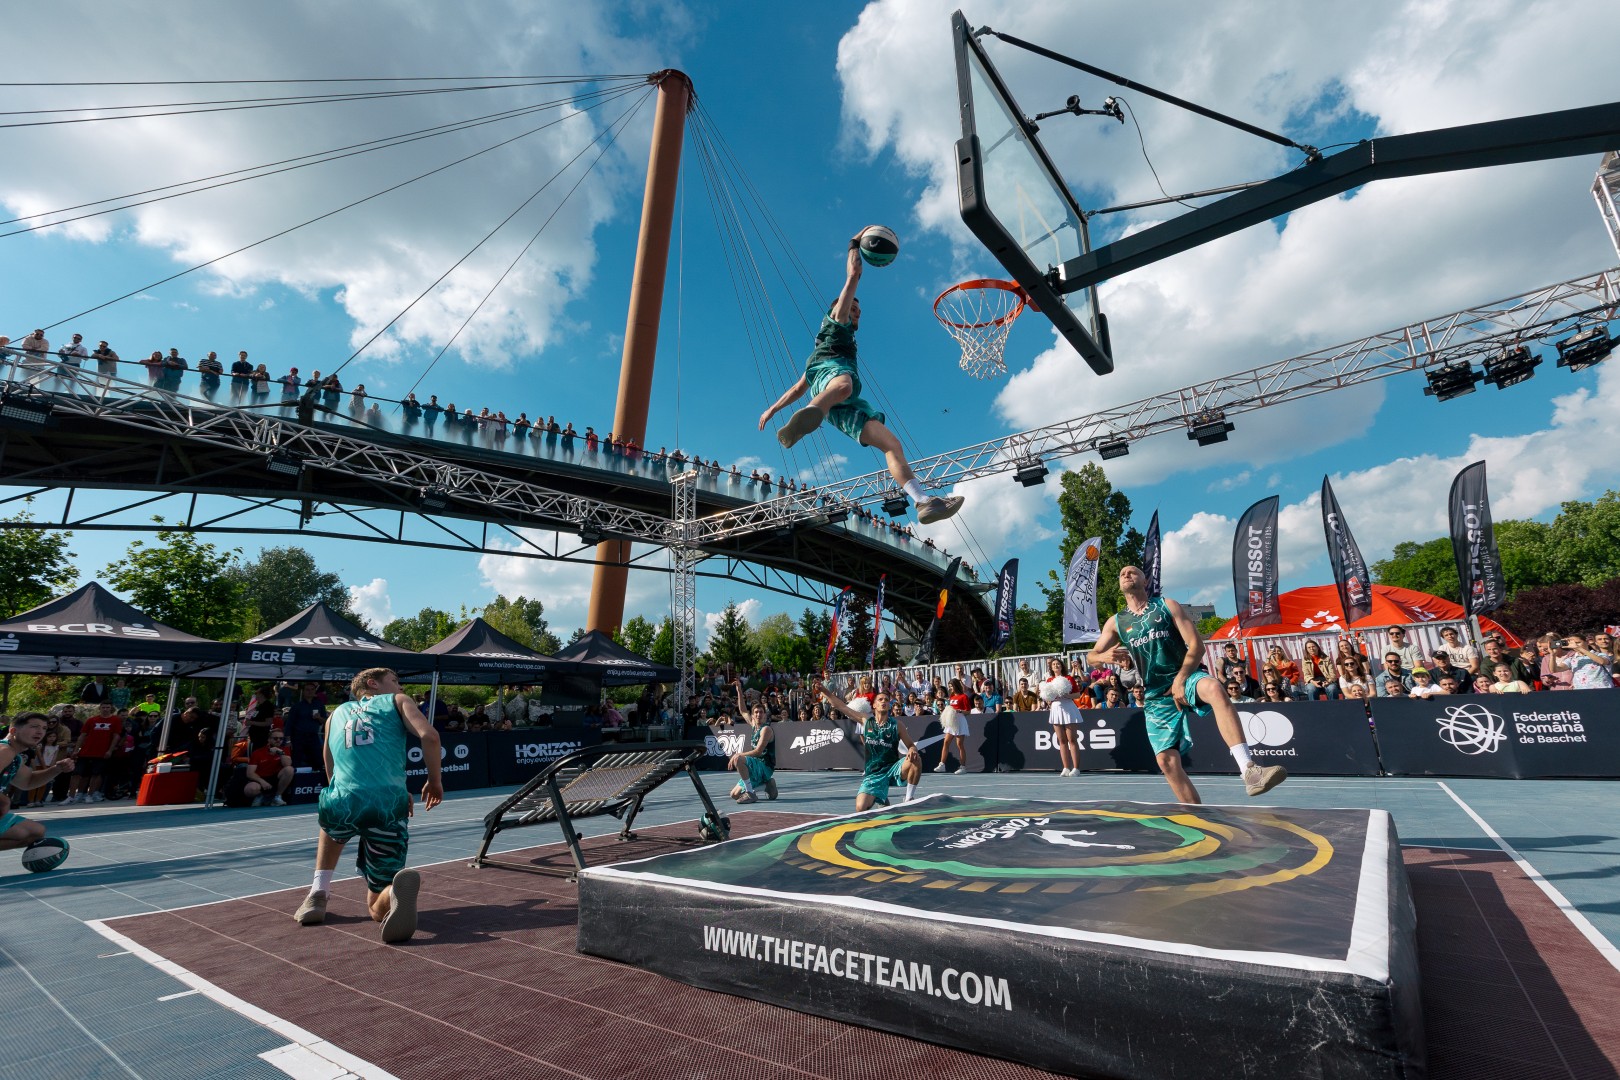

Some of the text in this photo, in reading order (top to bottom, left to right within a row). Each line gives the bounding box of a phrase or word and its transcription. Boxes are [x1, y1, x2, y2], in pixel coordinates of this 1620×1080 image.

[1247, 525, 1263, 590] TISSOT
[998, 569, 1011, 620] TISSOT
[28, 623, 116, 635] BCR
[291, 636, 353, 647] BCR
[251, 650, 280, 662] BCR
[478, 661, 546, 671] www.horizon-europe.com
[606, 668, 657, 677] enjoy.evolve.entertain
[1512, 710, 1581, 723] Federația
[1515, 721, 1585, 734] Română
[344, 718, 375, 750] 15
[1519, 734, 1587, 744] de Baschet
[789, 734, 831, 749] ARENA
[1230, 747, 1296, 757] stercard
[295, 786, 313, 795] BCR
[703, 925, 1013, 1011] WWW.THEFACETEAM.COM
